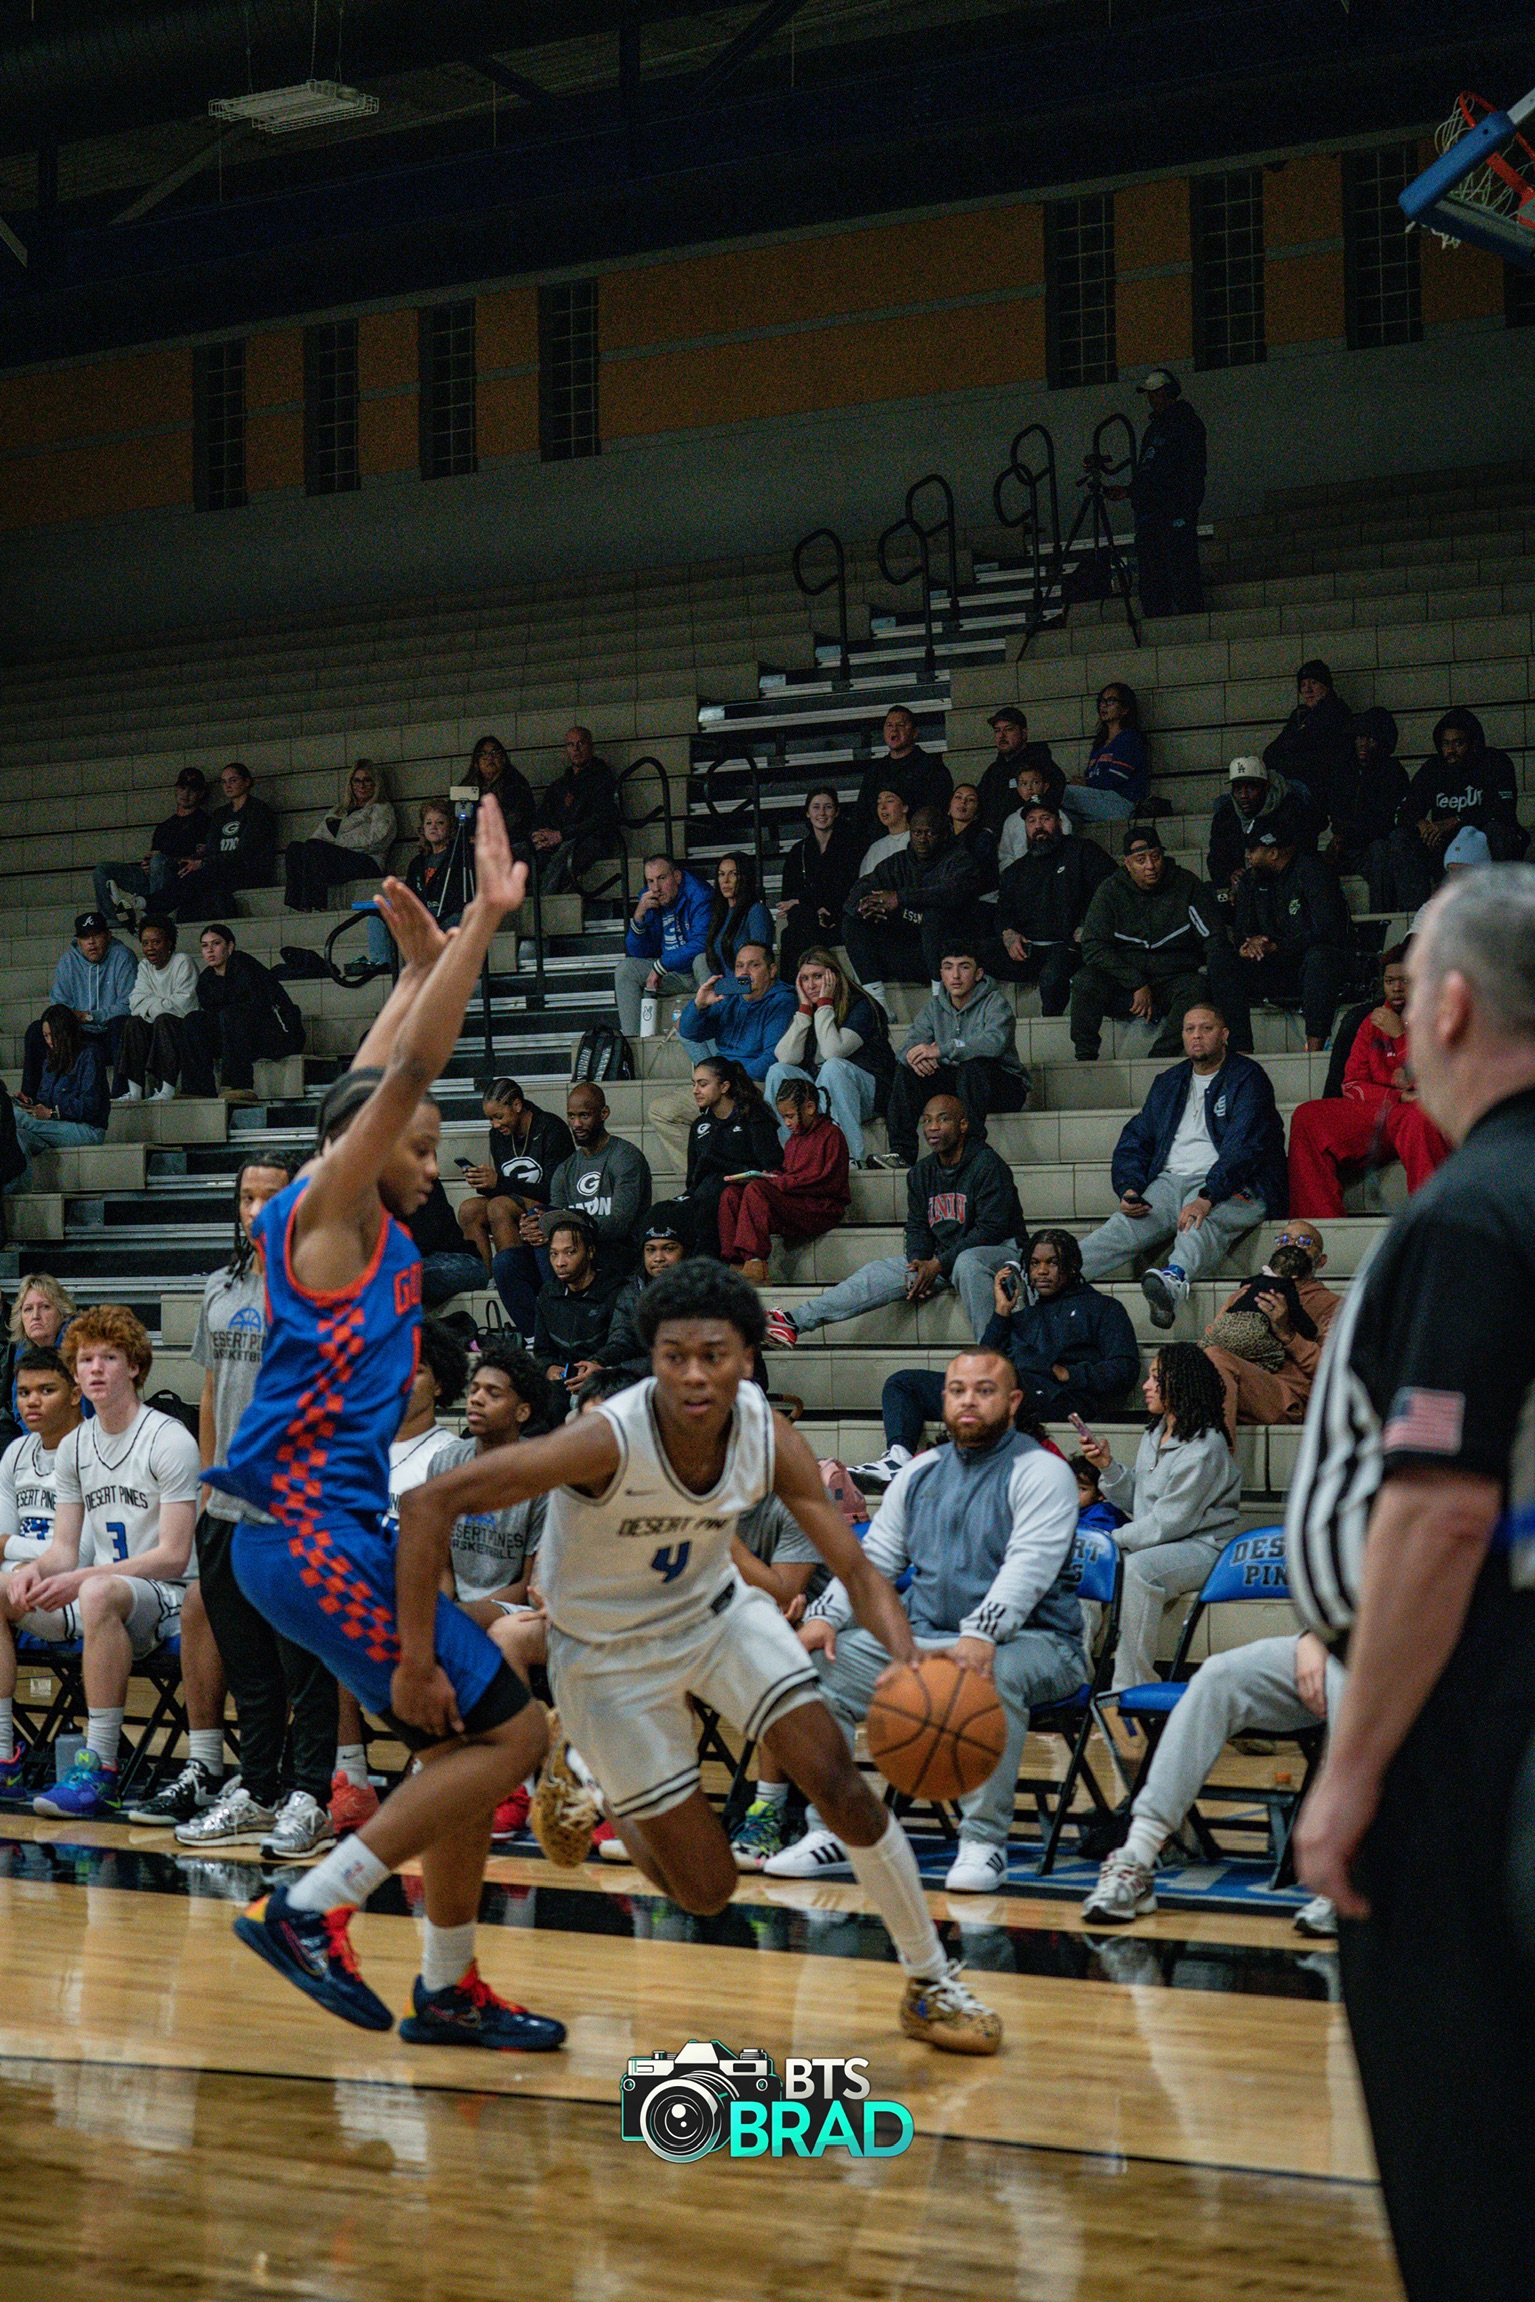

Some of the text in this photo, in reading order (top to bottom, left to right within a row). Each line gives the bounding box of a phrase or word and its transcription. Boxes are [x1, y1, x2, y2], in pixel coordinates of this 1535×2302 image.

[85, 1485, 148, 1512] DESERT PINES
[106, 1522, 129, 1563] 3
[651, 1541, 690, 1583] 4
